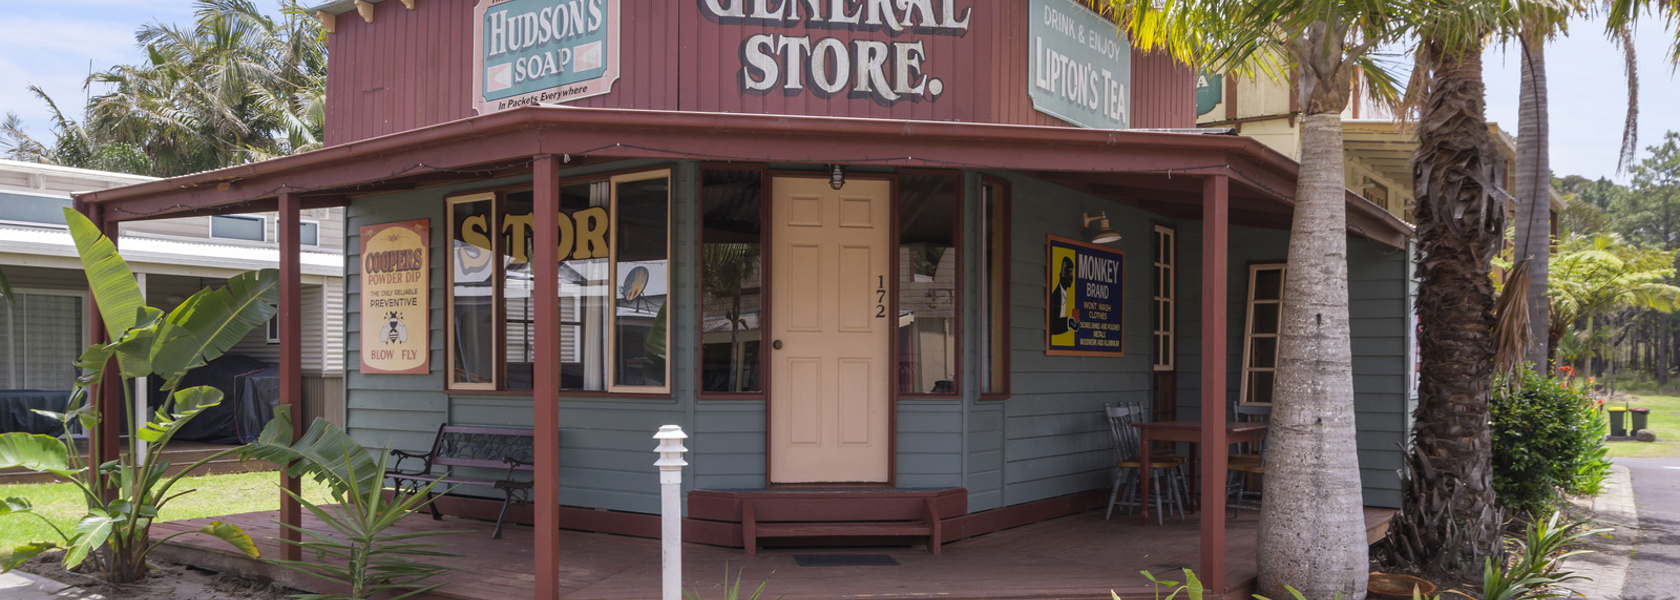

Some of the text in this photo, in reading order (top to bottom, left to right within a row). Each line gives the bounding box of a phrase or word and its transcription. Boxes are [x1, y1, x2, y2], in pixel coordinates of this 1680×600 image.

[1044, 5, 1120, 62] DRINK & ENJOY
[514, 48, 572, 83] SOAP
[744, 34, 943, 101] STORE.
[1036, 36, 1126, 124] LIPTON'S TEA
[498, 85, 588, 110] In Packets Everywhere
[365, 248, 423, 274] COOPERS
[1078, 254, 1119, 284] MONKEY
[368, 272, 421, 285] POWDER DIP
[1086, 282, 1110, 299] BRAND
[370, 298, 417, 308] PREVENTIVE
[394, 288, 418, 296] RELIABLE
[876, 275, 886, 318] 172
[1089, 311, 1108, 320] CLOTHES
[1098, 303, 1111, 312] WASH
[371, 349, 418, 360] BLOW FLY
